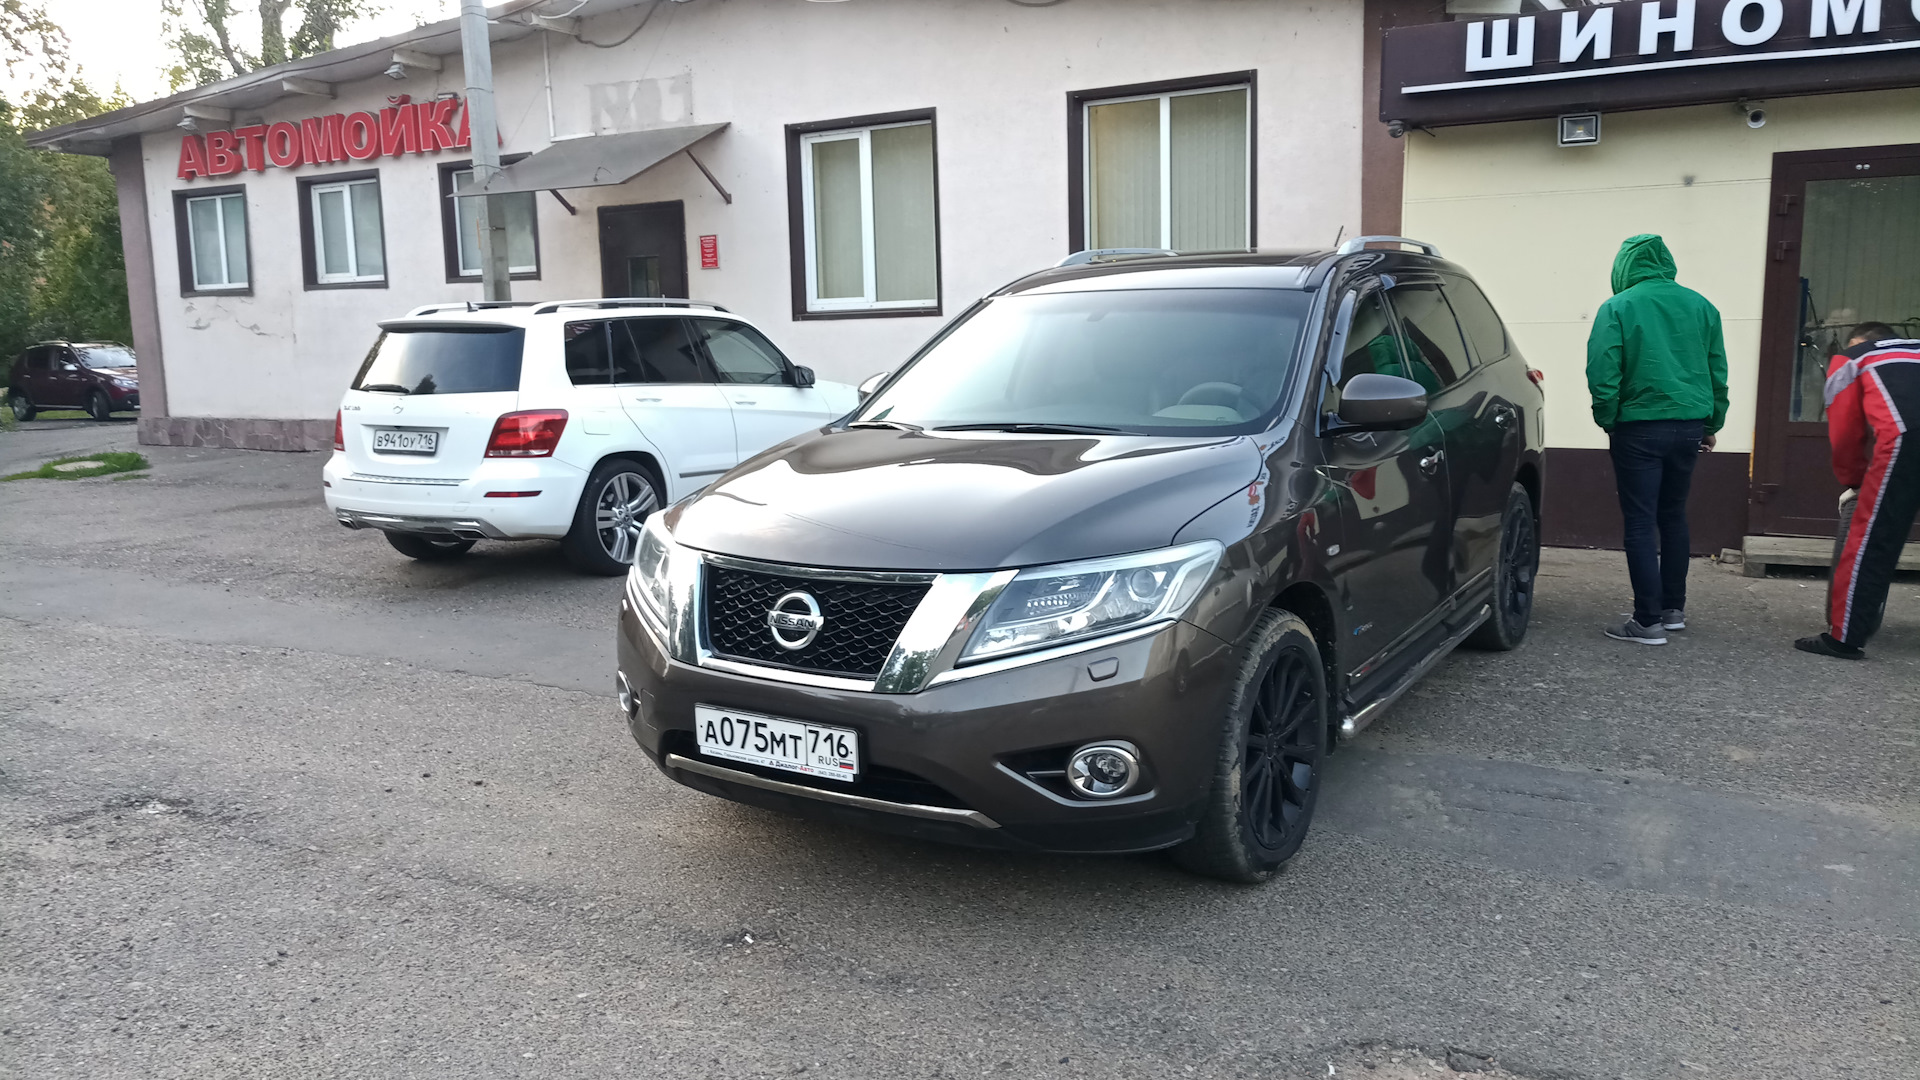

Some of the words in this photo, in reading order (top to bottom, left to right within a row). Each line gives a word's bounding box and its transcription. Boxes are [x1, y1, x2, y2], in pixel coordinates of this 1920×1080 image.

[1465, 0, 1920, 73] ШИНОМ
[417, 433, 434, 446] 716
[770, 613, 816, 629] NISSAN
[705, 716, 802, 759] А075МТ
[808, 729, 849, 758] 716
[818, 755, 839, 767] RUS
